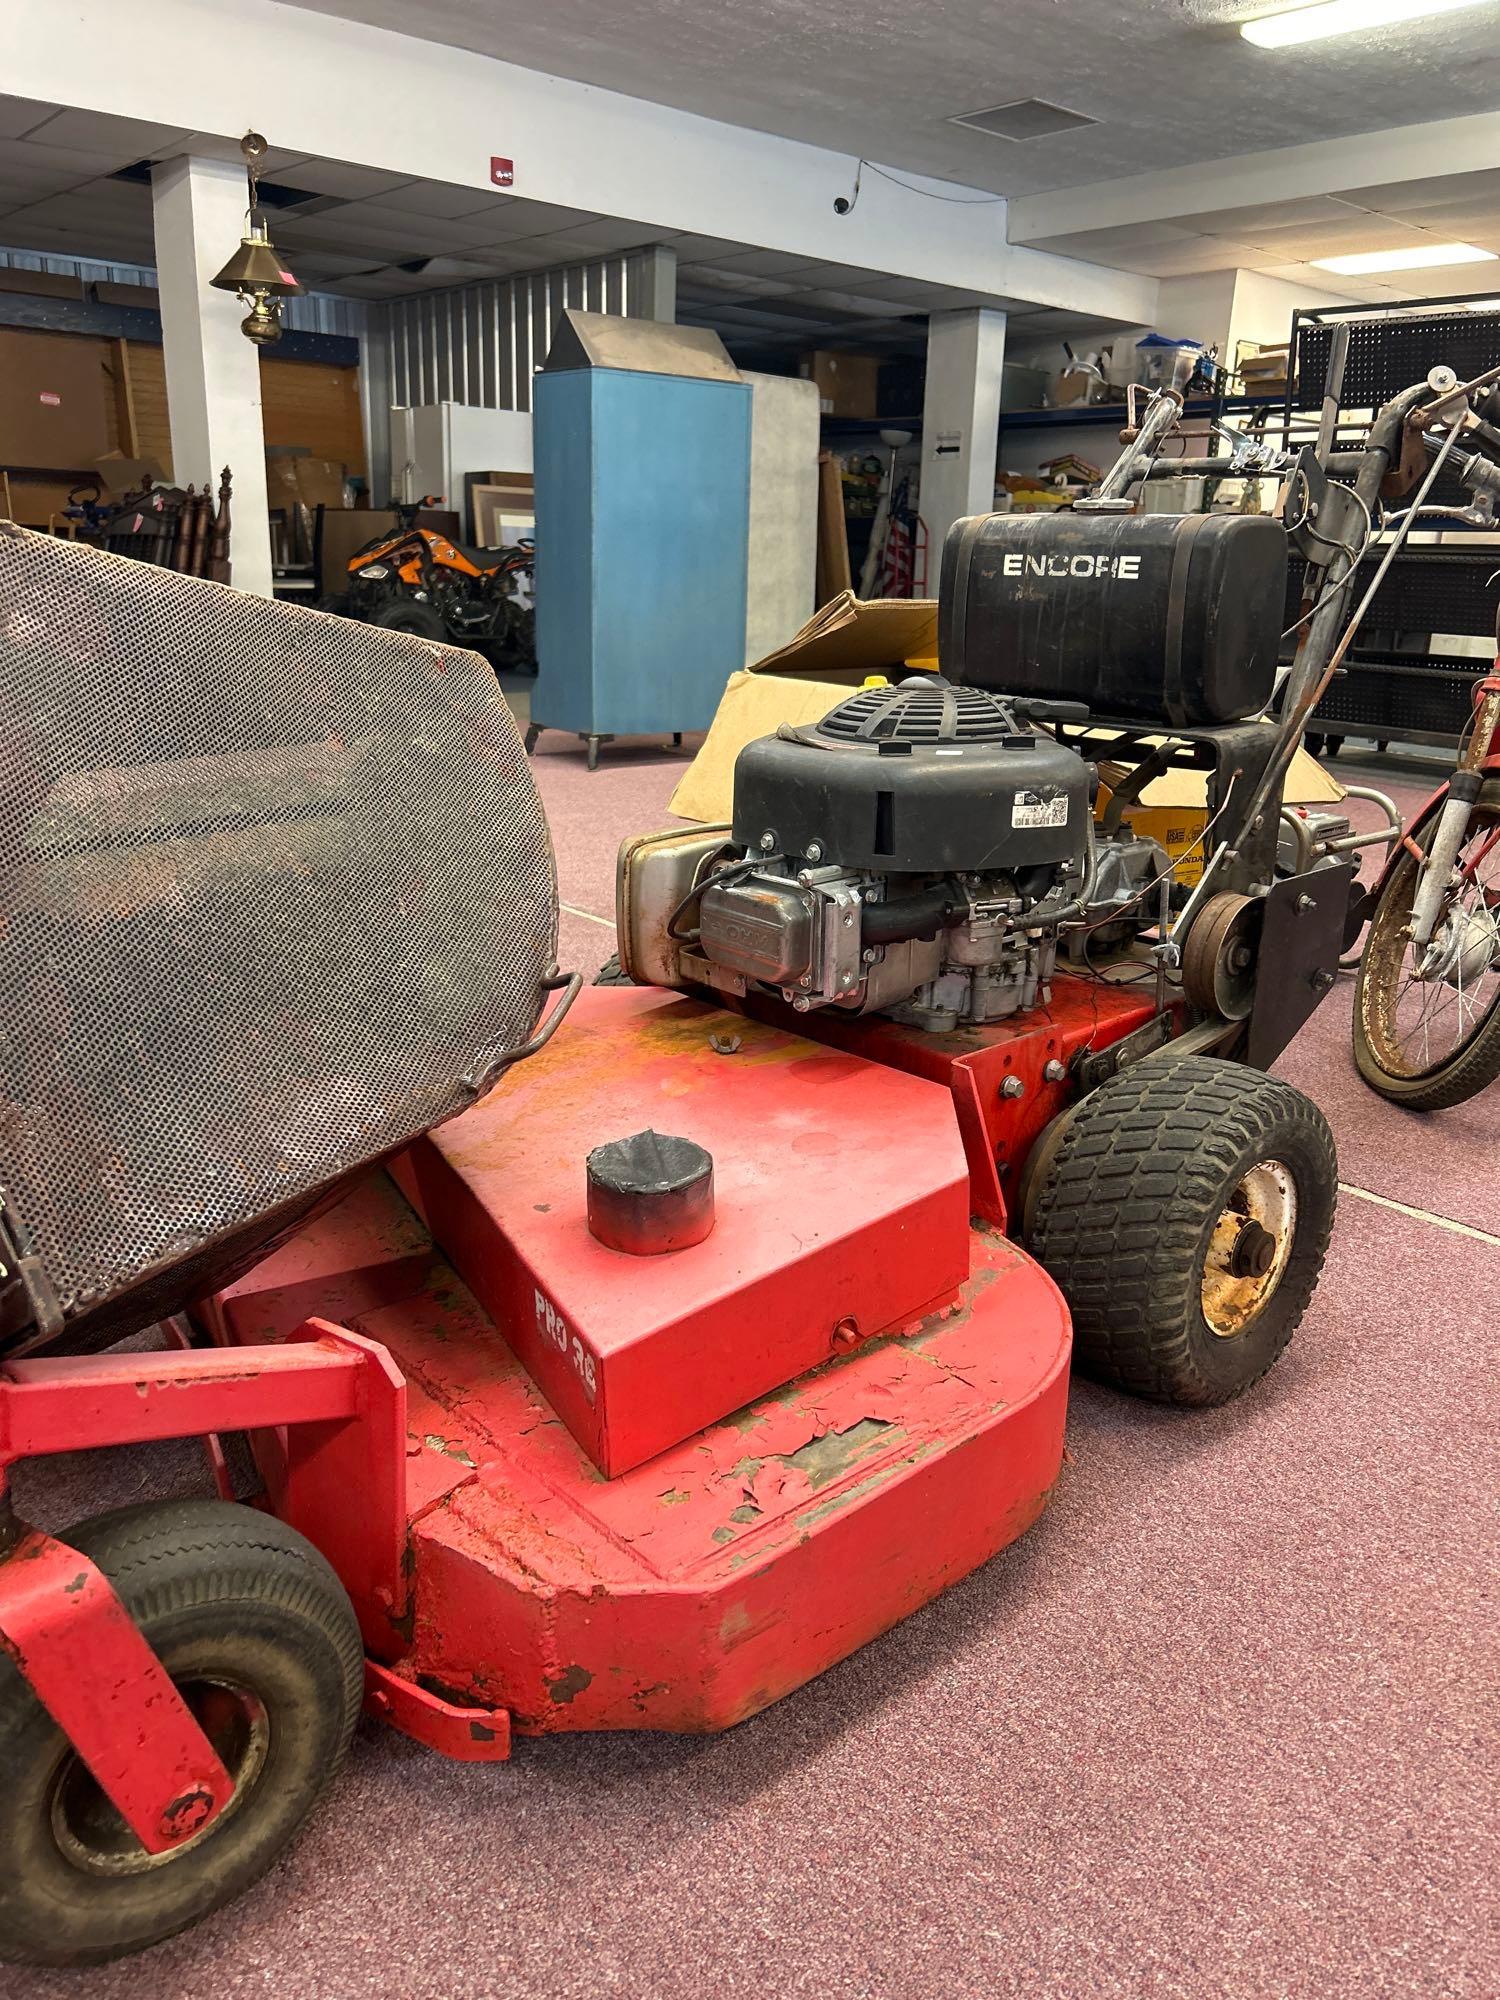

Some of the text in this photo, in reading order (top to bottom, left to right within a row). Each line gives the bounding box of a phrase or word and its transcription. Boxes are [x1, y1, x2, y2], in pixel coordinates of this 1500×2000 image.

[1003, 554, 1141, 579] ENCORE
[1172, 856, 1203, 865] HONDA
[535, 1288, 567, 1352] PRO
